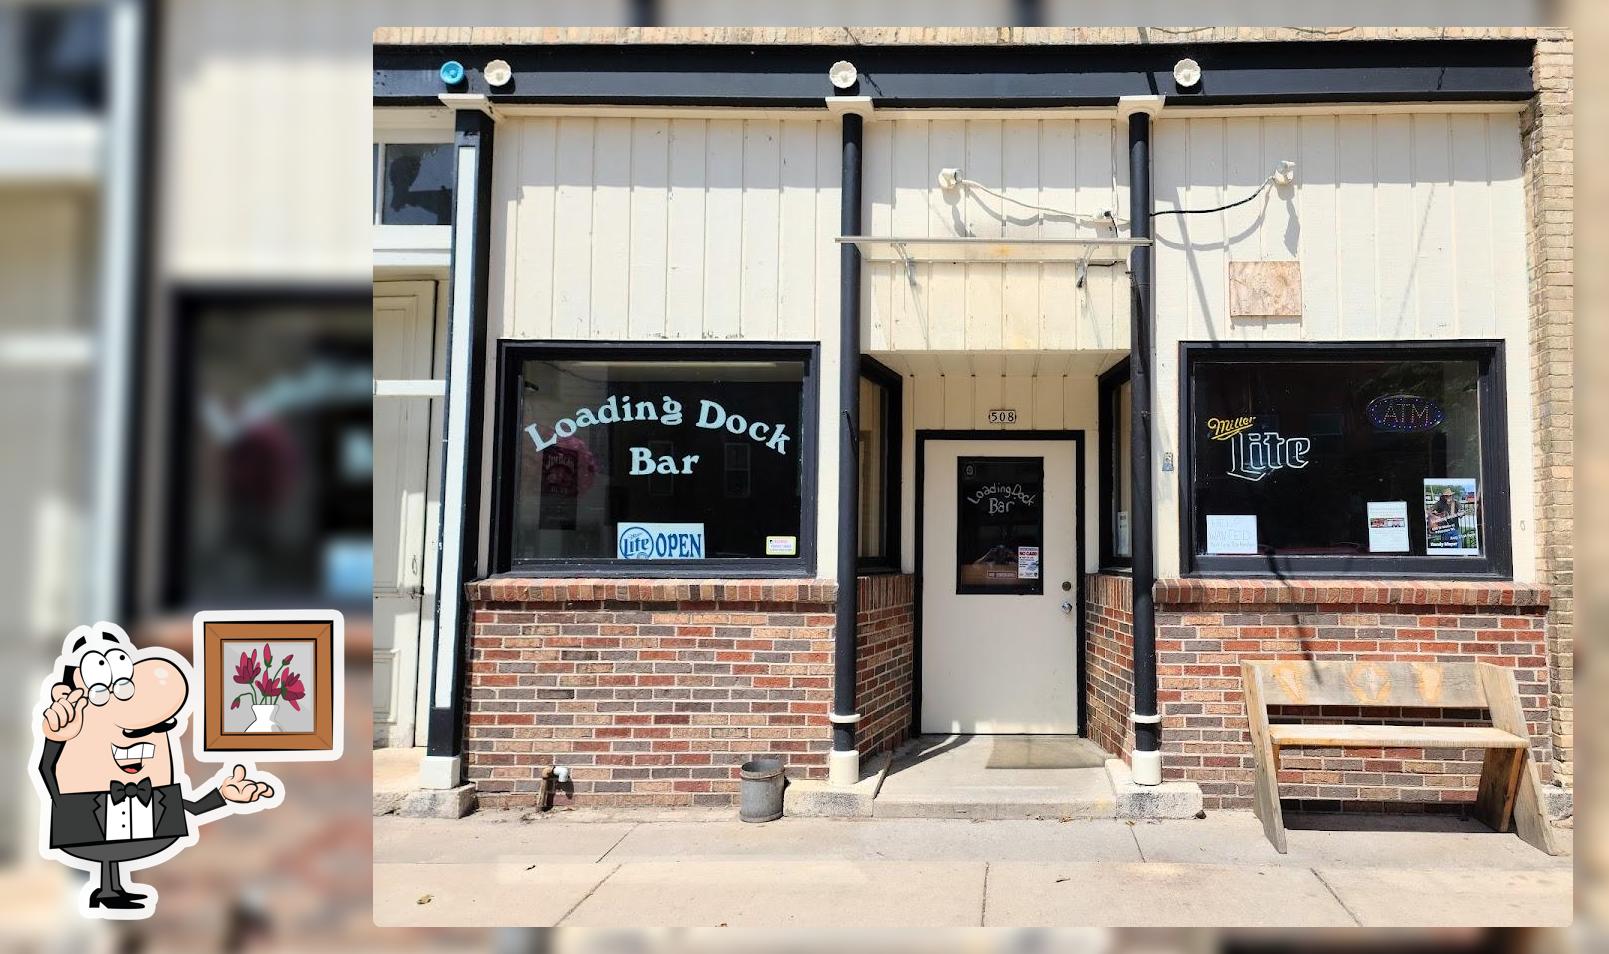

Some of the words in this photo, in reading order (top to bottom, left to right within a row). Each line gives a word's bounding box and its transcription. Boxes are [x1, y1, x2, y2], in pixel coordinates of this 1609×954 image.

[524, 395, 683, 452] Loading
[695, 399, 791, 455] Dock
[991, 411, 1015, 422] 508
[1207, 416, 1257, 437] Miller
[1382, 403, 1429, 427] ATM
[629, 446, 700, 475] Bar
[1226, 432, 1311, 481] Lite
[967, 482, 1011, 504] Loading
[1011, 484, 1036, 506] Dock
[988, 497, 1015, 514] Bar
[623, 537, 650, 558] Lite
[656, 532, 702, 557] OPEN
